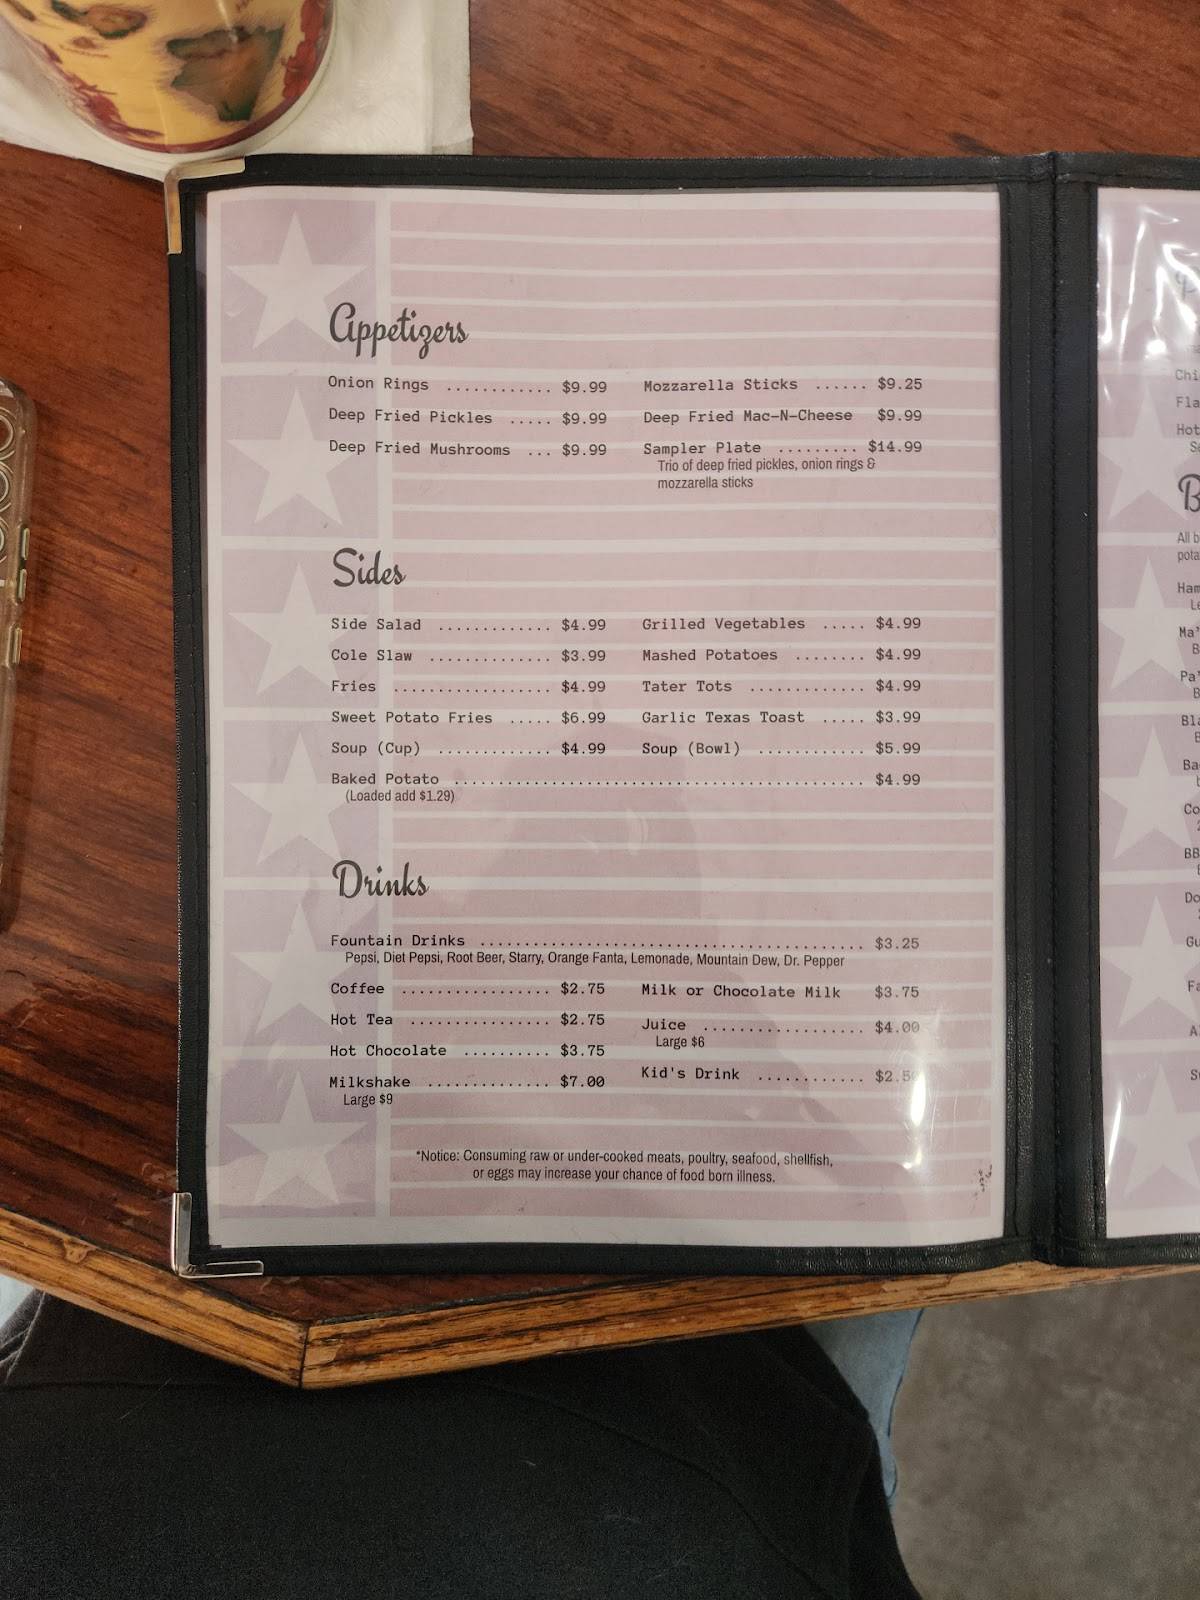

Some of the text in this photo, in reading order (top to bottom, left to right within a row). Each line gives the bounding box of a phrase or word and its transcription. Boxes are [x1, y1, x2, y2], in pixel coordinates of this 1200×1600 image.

[330, 302, 469, 359] Appetizers
[1175, 369, 1200, 381] Chi
[328, 376, 607, 394] Onion Rings $9.99
[644, 376, 922, 392] Mozzarella Sticks $9.25
[329, 408, 607, 426] Deep Fried Pickles $9.99
[644, 412, 679, 425] Deep
[689, 410, 733, 422] Fried
[878, 408, 922, 422] $9.99
[330, 440, 606, 457] Deep Fried Mushrooms $9.99
[644, 439, 922, 457] Sampler Plate $14.99
[657, 456, 876, 473] Trio of deep fried pickles, onion rings &
[658, 476, 753, 488] mozzarella sticks
[333, 548, 407, 587] Sides
[331, 618, 606, 632] Side Salad $4.99
[642, 616, 921, 632] Grilled Vegetables $4.99
[331, 649, 606, 663] Cole Slaw $3.99
[643, 647, 921, 661] Mashed Potatoes $4.99
[332, 680, 605, 694] Fries $4.99
[642, 678, 921, 693] Tater Tots $4.99
[332, 711, 605, 725] Sweet Potato Fries $6.99
[642, 710, 920, 724] Garlic Texas Toast $3.99
[332, 741, 605, 757] Soup (Cup) $4.99
[642, 741, 920, 757] Soup (Bowl) $5.99
[332, 772, 920, 786] Baked Potato $4.99
[346, 788, 454, 804] (Loaded add $1.29)
[332, 860, 430, 899] Drinks
[332, 934, 919, 951] Fountain Drinks $3.25
[346, 951, 845, 968] Pepsi, Diet Pepsi, Root Beer, Starry, Orange Fanta, Lemonade, Mountain Dew, Dr. Pepper
[331, 981, 605, 995] Coffee $2.75
[642, 984, 919, 1000] Milk or Chocolate Milk $3.75
[331, 1012, 604, 1026] Hot Tea $2.75
[642, 1018, 920, 1035] Juice $4.00
[331, 1043, 604, 1057] Hot Chocolate $3.75
[656, 1035, 704, 1050] Large $6
[330, 1074, 605, 1088] Milkshake $7.00
[642, 1066, 685, 1079] Kid's
[696, 1068, 739, 1080] Drink
[344, 1093, 392, 1108] Large $9
[464, 1149, 526, 1163] Consuming
[530, 1152, 550, 1161] raw
[553, 1152, 564, 1161] or
[568, 1149, 643, 1163] under-cooked
[647, 1152, 684, 1165] meats,
[688, 1152, 728, 1167] poultry,
[732, 1152, 780, 1166] seafood,
[784, 1153, 832, 1167] shellfish,
[473, 1166, 775, 1183] or eggs may increase your chance of food born illness.
